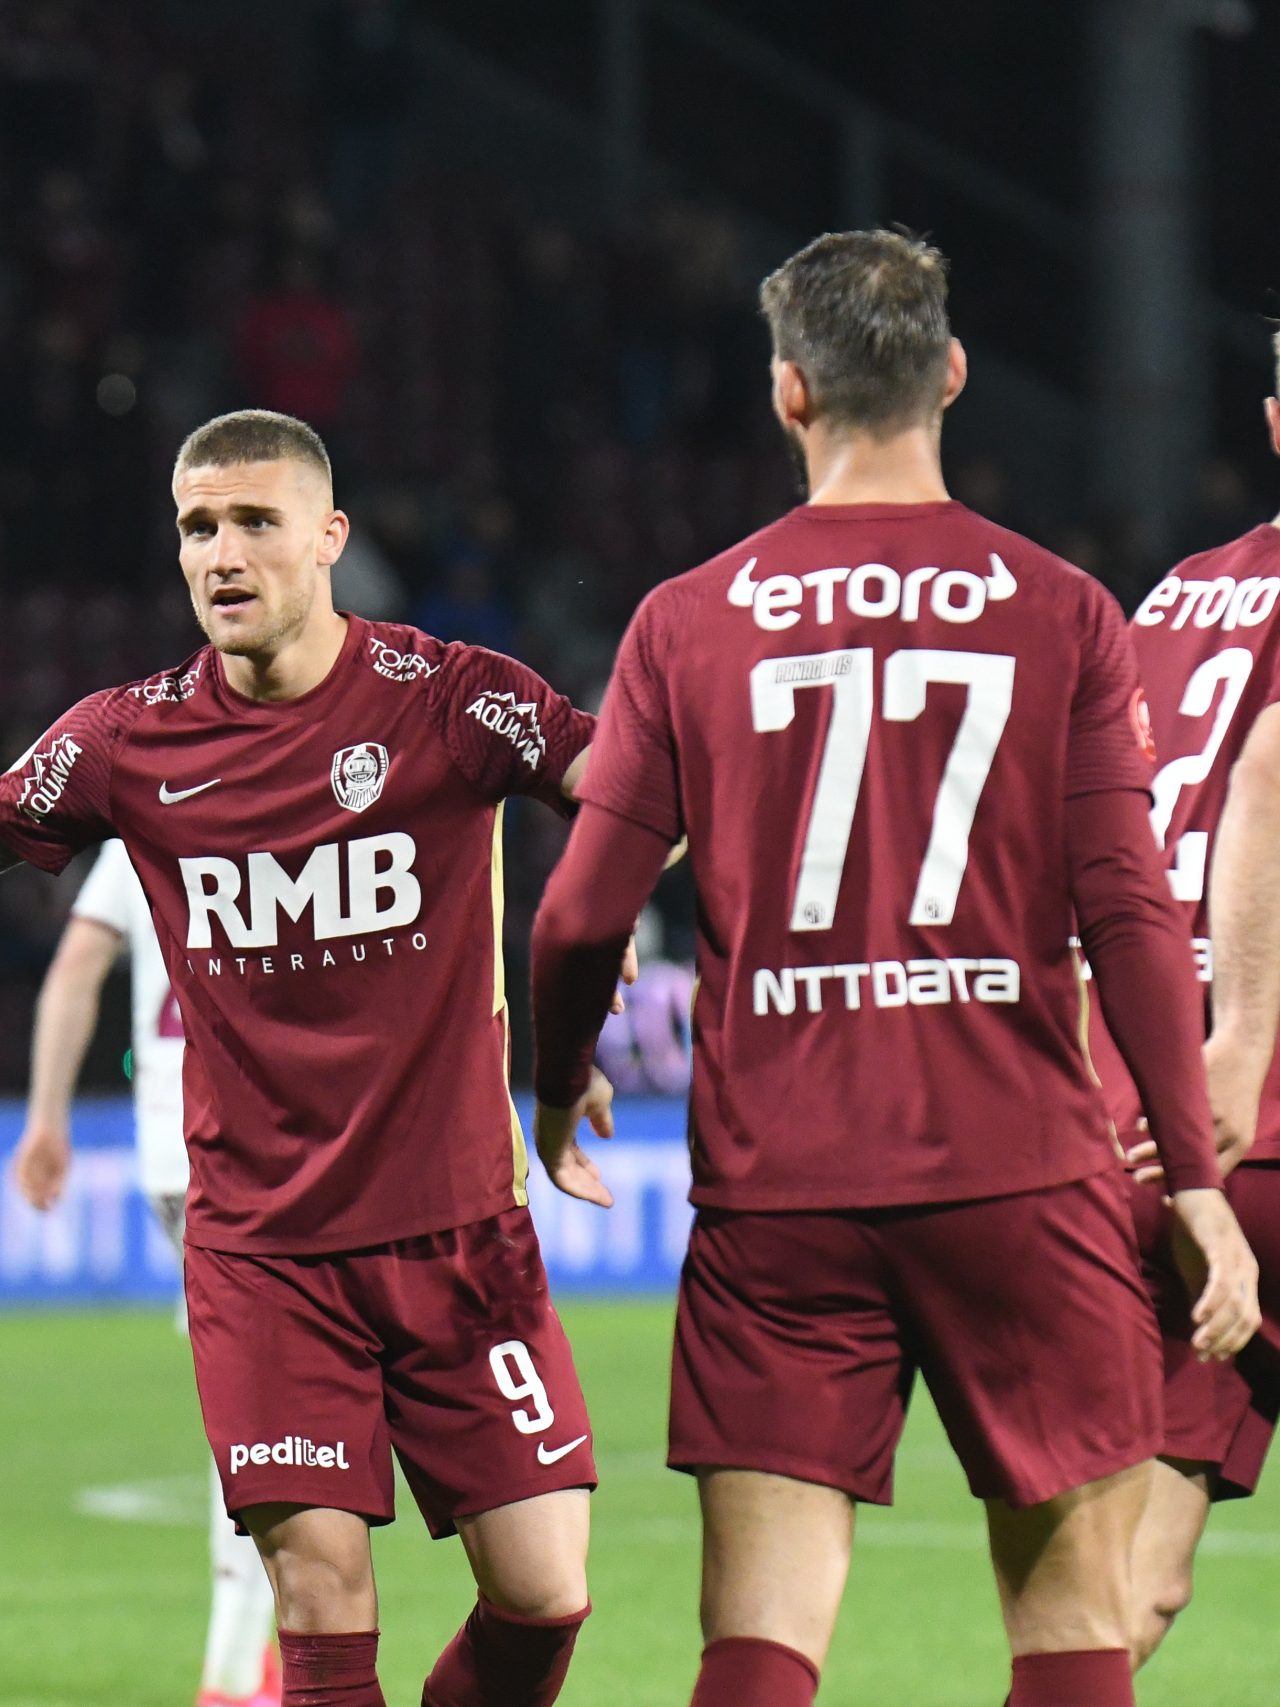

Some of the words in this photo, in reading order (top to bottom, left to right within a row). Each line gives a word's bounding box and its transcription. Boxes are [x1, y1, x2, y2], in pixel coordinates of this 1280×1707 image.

[753, 563, 986, 631] eToro
[750, 647, 1016, 932] 77
[178, 831, 422, 949] RMB
[753, 963, 870, 1016] NTT
[488, 1340, 555, 1435] 9
[230, 1435, 350, 1475] peditel
